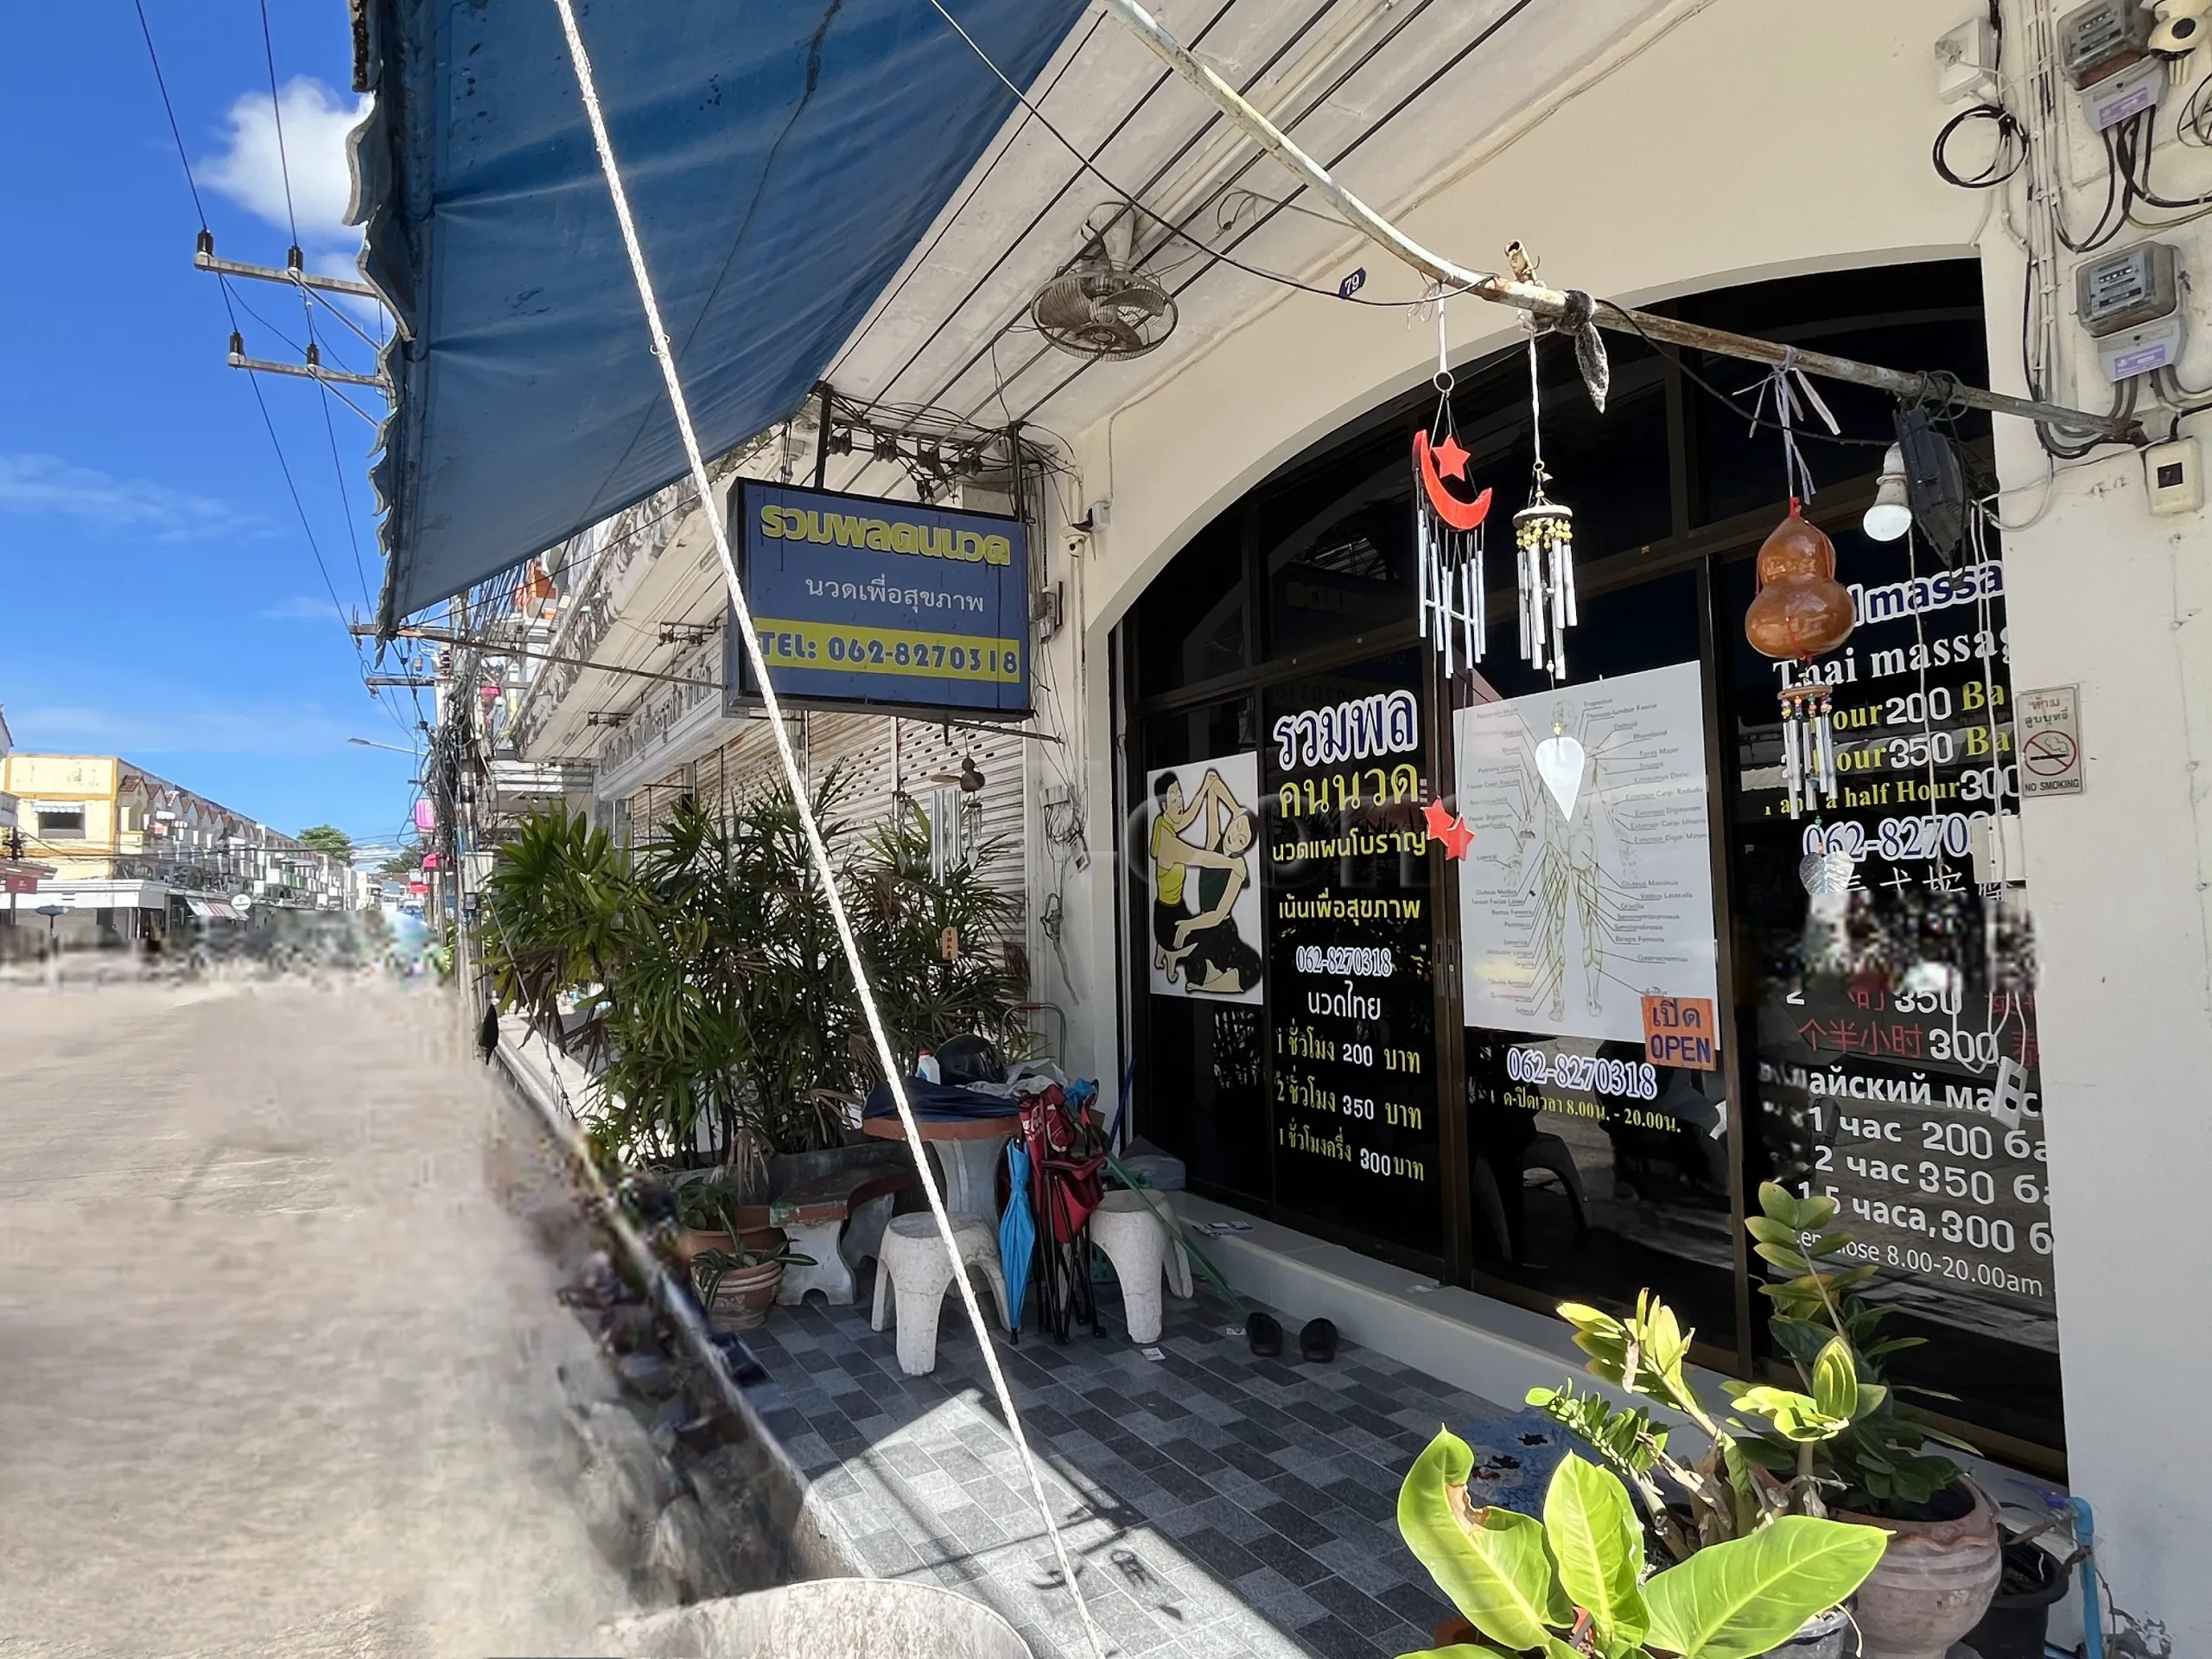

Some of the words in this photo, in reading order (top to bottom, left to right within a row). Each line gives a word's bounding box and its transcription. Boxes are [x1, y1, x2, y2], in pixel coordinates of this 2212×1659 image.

[1344, 273, 1360, 296] 79
[760, 504, 1011, 567] รวมพลคนนวด
[804, 573, 984, 613] นวดเพื่อสุขภาพ
[827, 636, 1018, 675] 062-8270318
[1885, 687, 1953, 726] 200
[1273, 689, 1419, 771] รวมพล
[1889, 732, 1955, 769] 350
[1279, 763, 1419, 818] คนนวด
[1845, 782, 1891, 807] half
[1896, 779, 1961, 804] Hour
[2024, 782, 2037, 792] NO
[2039, 779, 2080, 791] SMOKING
[1279, 887, 1421, 926] เน้นเพื่อสุขภาพ
[1295, 945, 1392, 977] 062-8270318
[1307, 981, 1382, 1020] นวดไทย
[1652, 999, 1701, 1029] เปิด
[1287, 1018, 1336, 1062] ชั่วโมง
[1342, 1043, 1373, 1067] 200
[1383, 1047, 1421, 1074] บาท
[1650, 1033, 1712, 1064] OPEN
[1798, 1018, 1923, 1059] 个半小时
[1928, 1027, 1999, 1065] 300
[1506, 1047, 1658, 1100] 062-8270318
[1276, 1078, 1285, 1103] 2
[1287, 1065, 1336, 1113] ชั่วโมง
[1342, 1095, 1375, 1121] 350
[1384, 1102, 1422, 1130] บาท
[1808, 1107, 1822, 1132] 1
[1839, 1115, 1902, 1142] час
[1921, 1121, 1994, 1160] 200
[1359, 1147, 1391, 1176] 300
[1392, 1156, 1425, 1182] บาท
[1814, 1145, 1834, 1173] 2
[1846, 1155, 1910, 1185] час
[1918, 1160, 1996, 1205] 350
[1886, 1244, 2044, 1298] 8.00-20.00am
